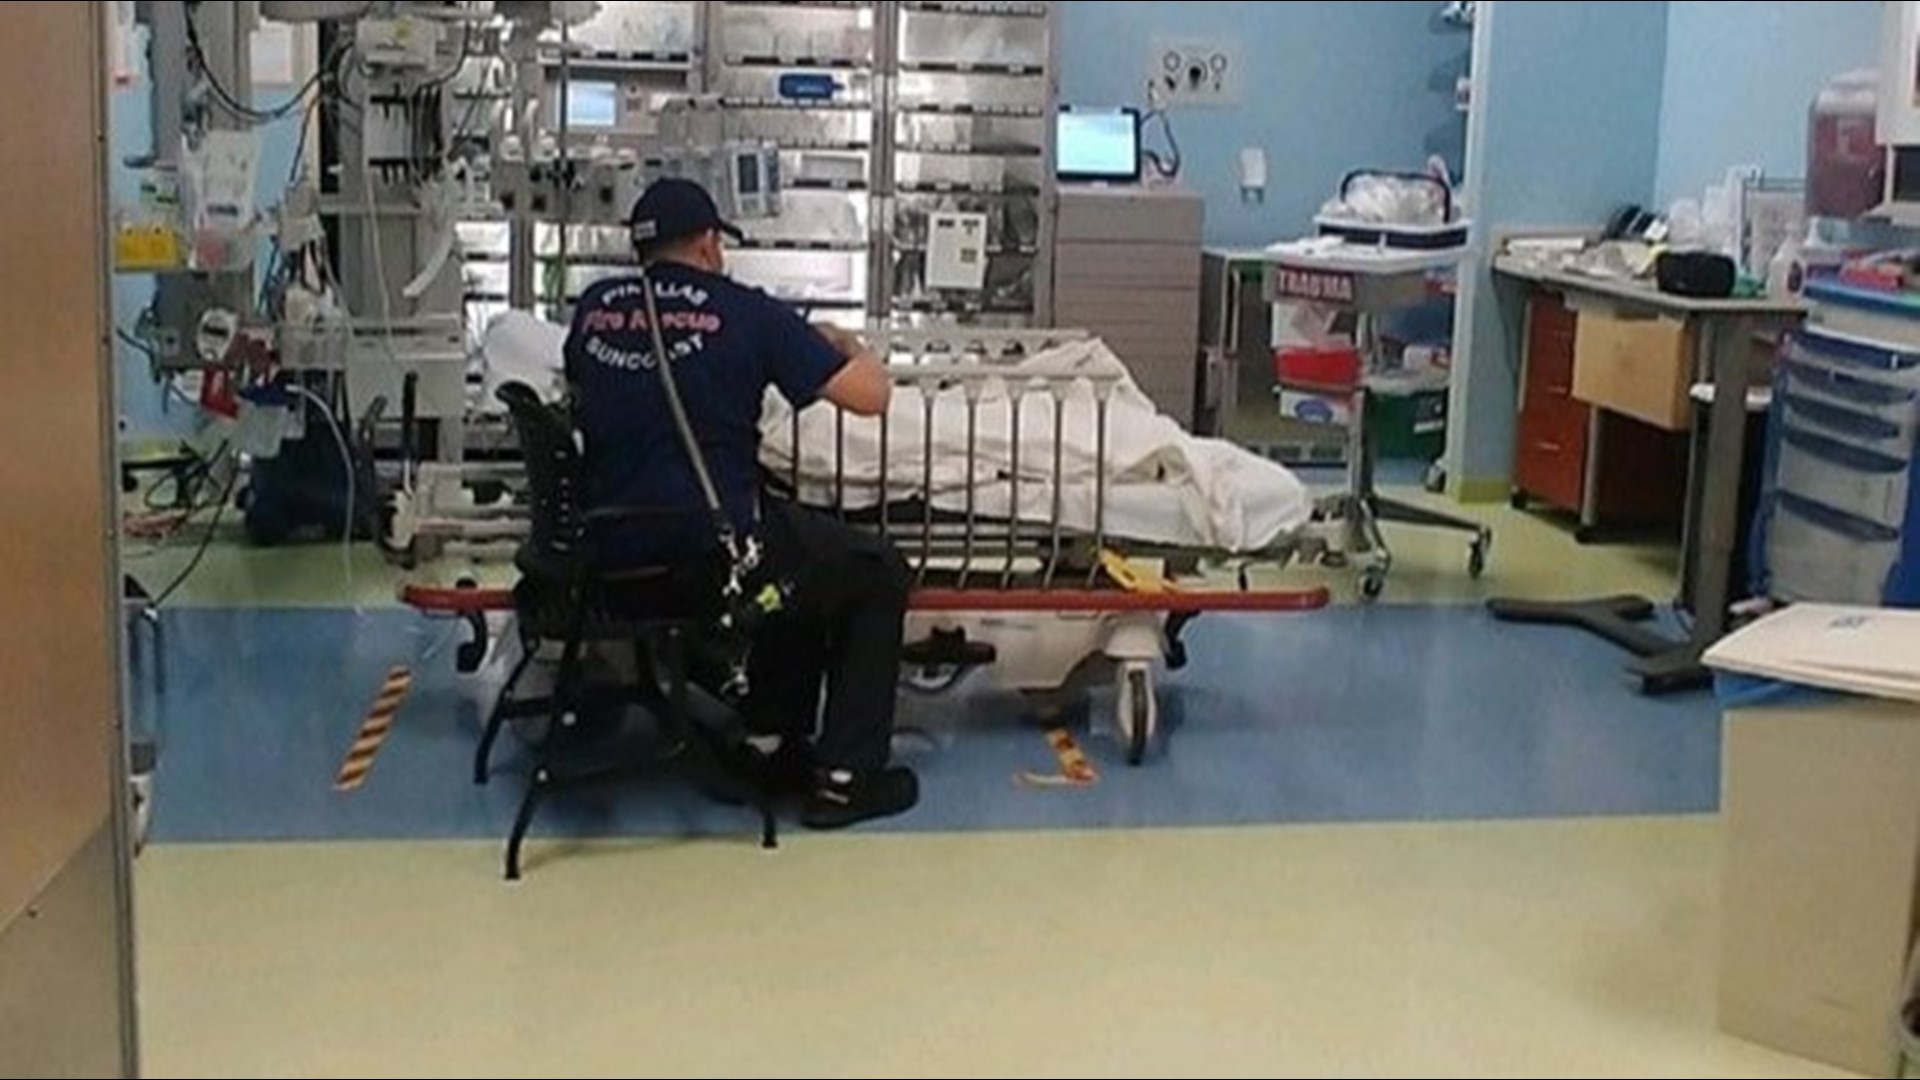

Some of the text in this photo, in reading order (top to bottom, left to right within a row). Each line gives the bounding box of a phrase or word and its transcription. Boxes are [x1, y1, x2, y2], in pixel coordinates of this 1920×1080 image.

[602, 281, 709, 306] PINLLAS
[1278, 269, 1353, 301] TRAUMA
[628, 310, 721, 333] Rscue
[586, 333, 703, 370] SUNCOST
